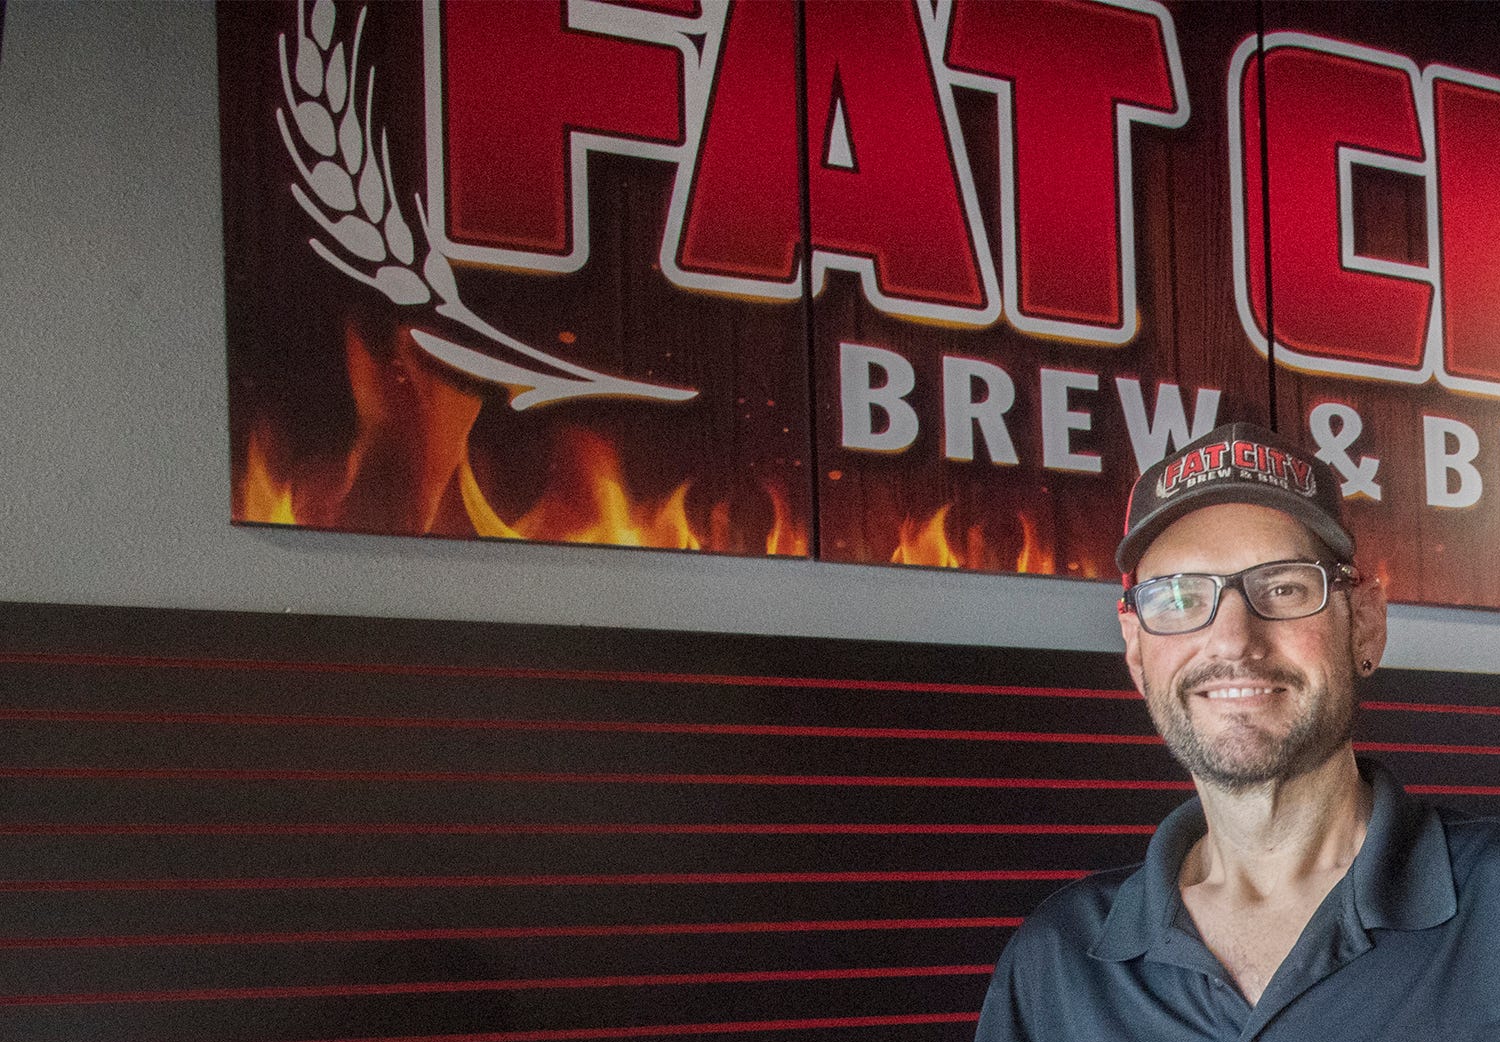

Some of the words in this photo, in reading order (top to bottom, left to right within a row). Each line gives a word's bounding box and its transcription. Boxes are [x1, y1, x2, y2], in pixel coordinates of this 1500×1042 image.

[424, 0, 1190, 345] FAT
[838, 343, 1221, 477] BREW
[1307, 402, 1382, 502] &
[1164, 440, 1231, 490] FAT
[1231, 439, 1312, 492] CITY
[1186, 466, 1232, 490] BREW
